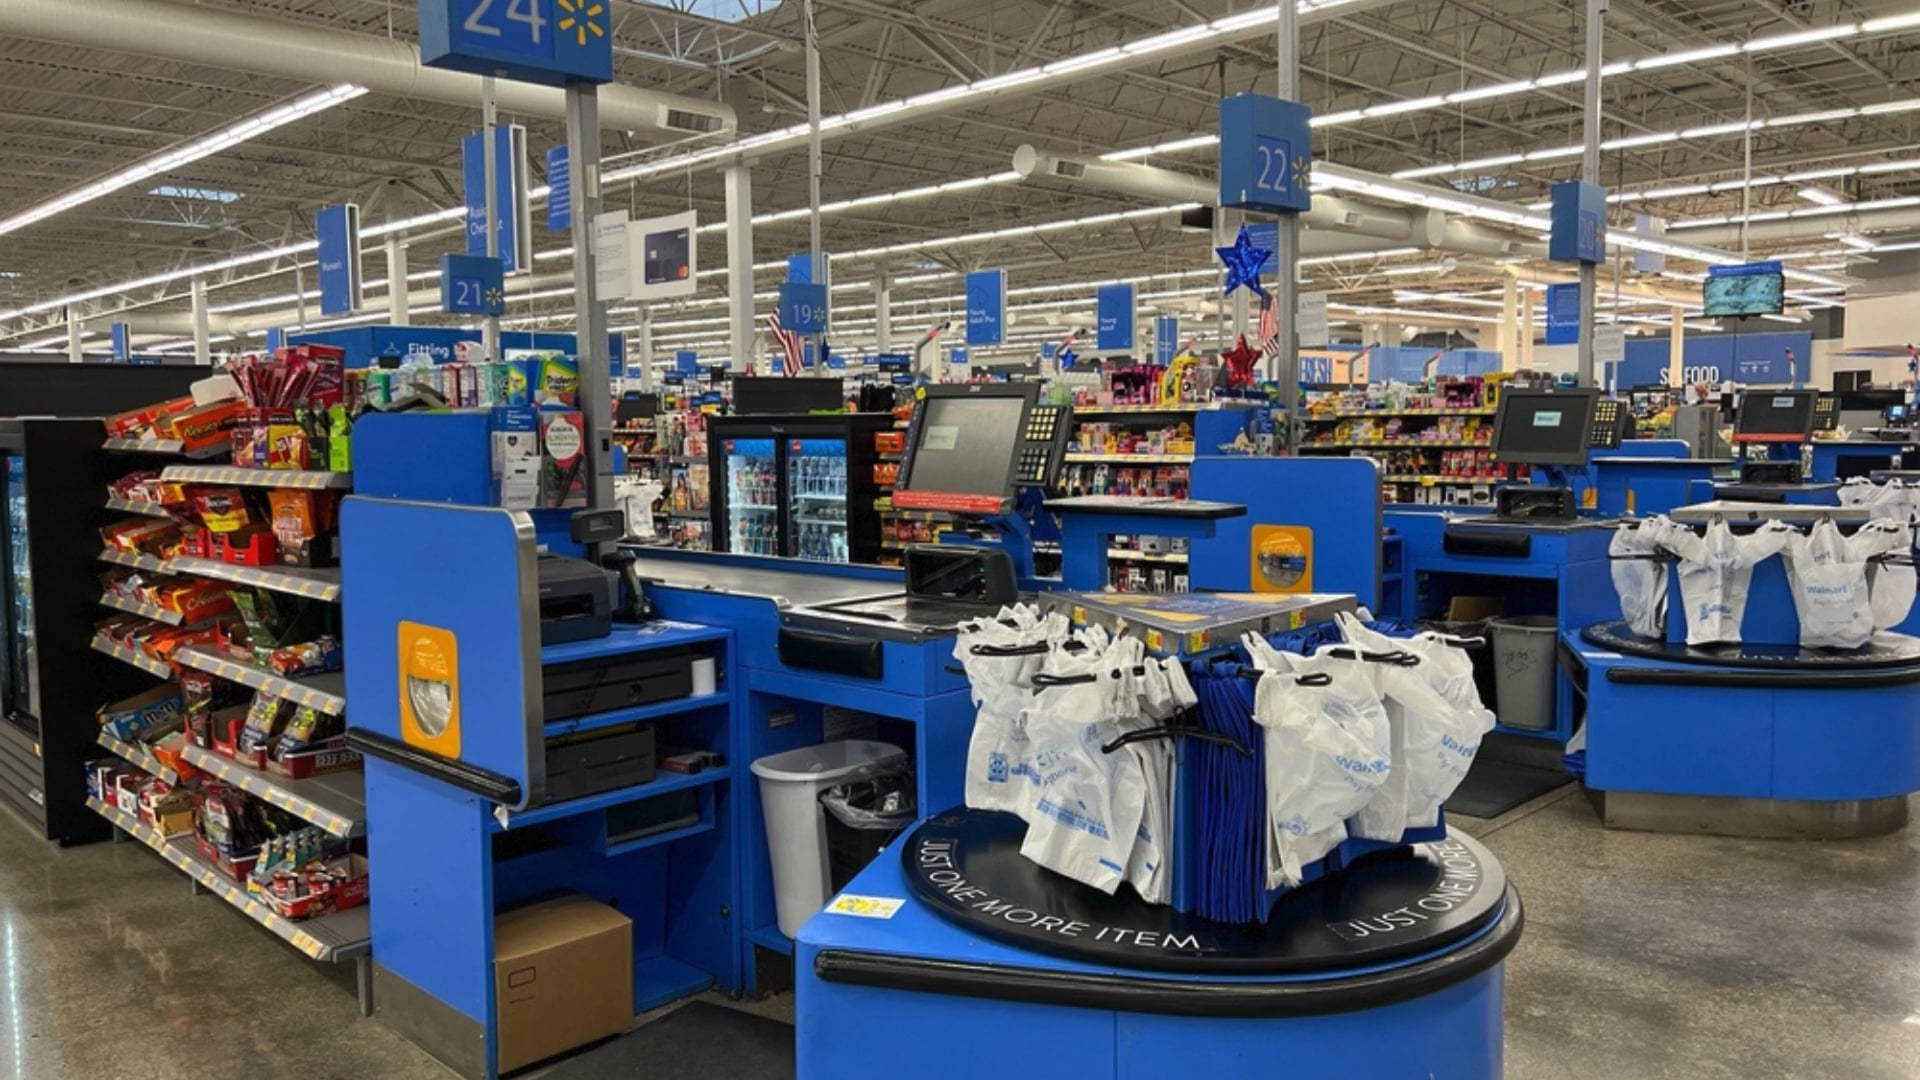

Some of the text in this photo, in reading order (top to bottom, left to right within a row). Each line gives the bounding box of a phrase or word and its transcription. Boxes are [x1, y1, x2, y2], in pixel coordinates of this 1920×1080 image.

[1257, 145, 1288, 192] 22
[456, 281, 480, 306] 21
[793, 304, 811, 324] 19
[408, 343, 449, 359] Fitting
[1807, 585, 1847, 594] Walmart
[920, 839, 1200, 950] JUST ONE MORE ITEM
[1348, 906, 1429, 938] JUST
[1417, 879, 1474, 911] ONE
